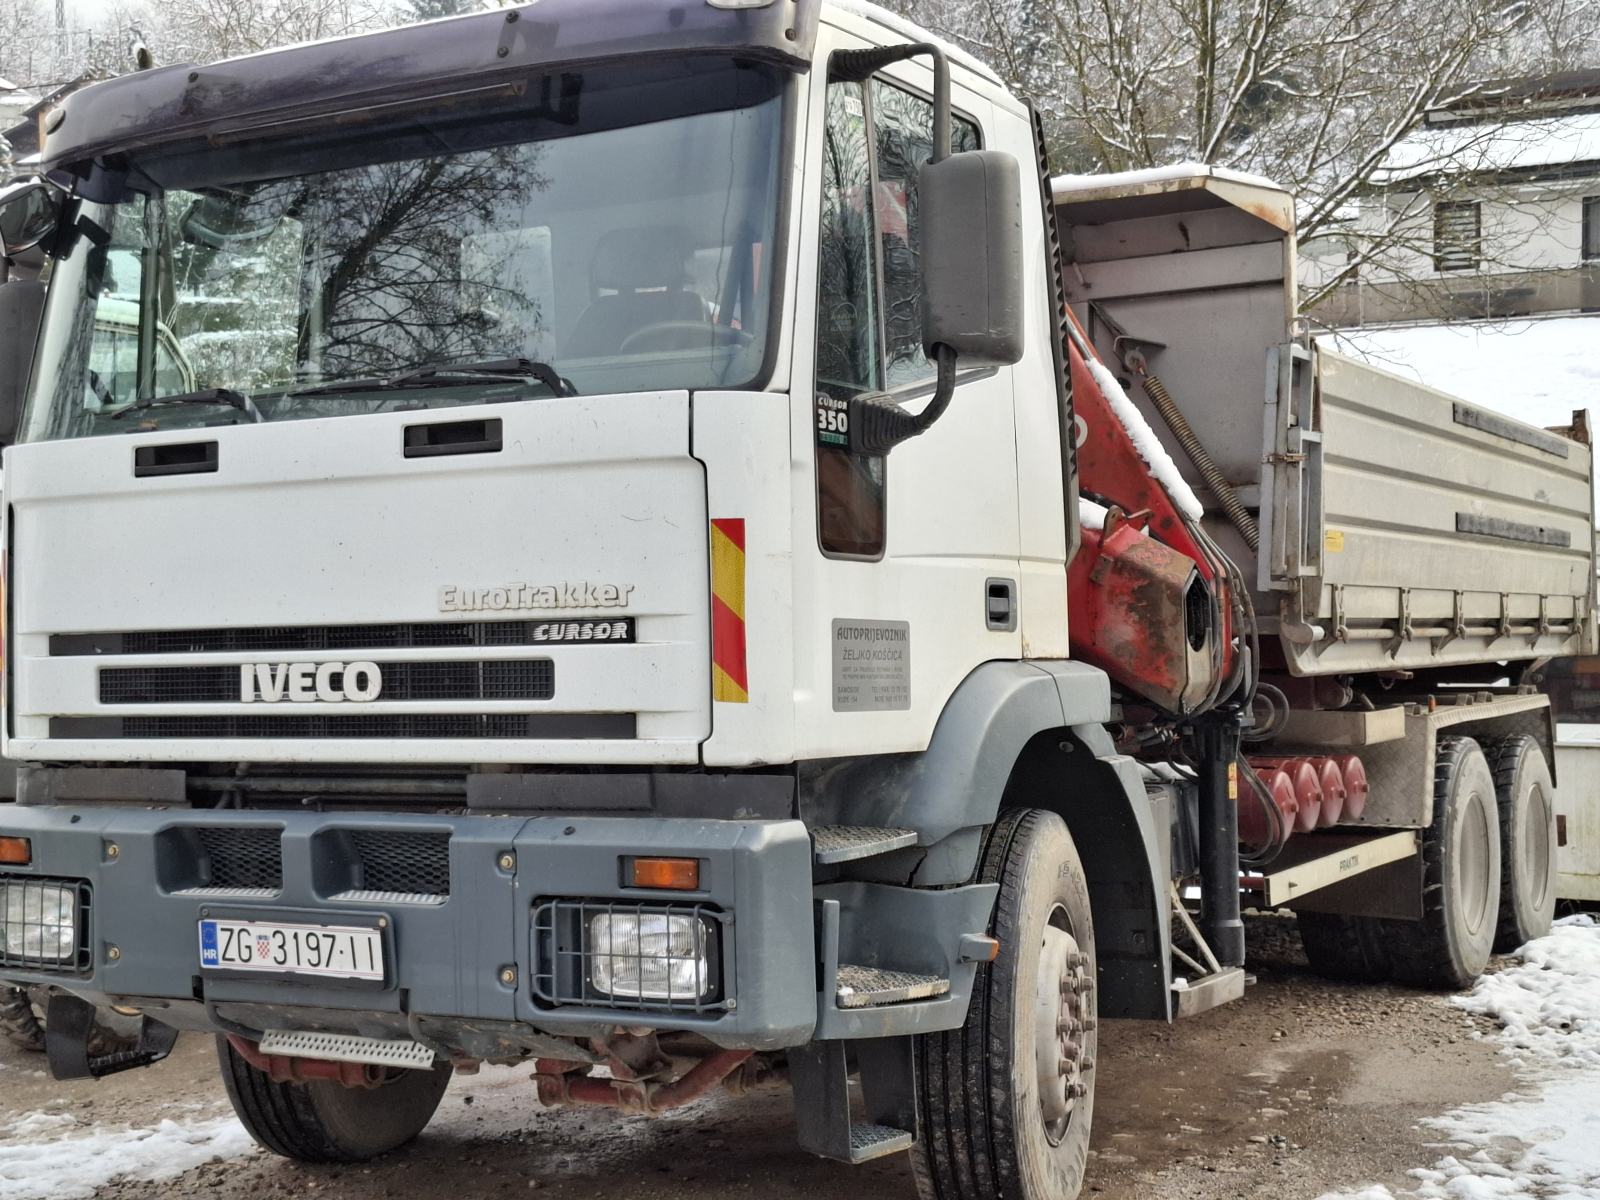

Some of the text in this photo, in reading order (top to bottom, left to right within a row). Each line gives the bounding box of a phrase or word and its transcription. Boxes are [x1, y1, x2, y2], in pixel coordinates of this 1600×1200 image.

[818, 409, 848, 433] 350
[439, 581, 634, 611] EuroTrakker
[532, 622, 628, 641] CURSOR
[837, 627, 907, 642] AUTOPRIJEVOZNIK
[241, 661, 383, 702] IVECO
[203, 948, 217, 960] HR
[220, 927, 252, 964] ZG
